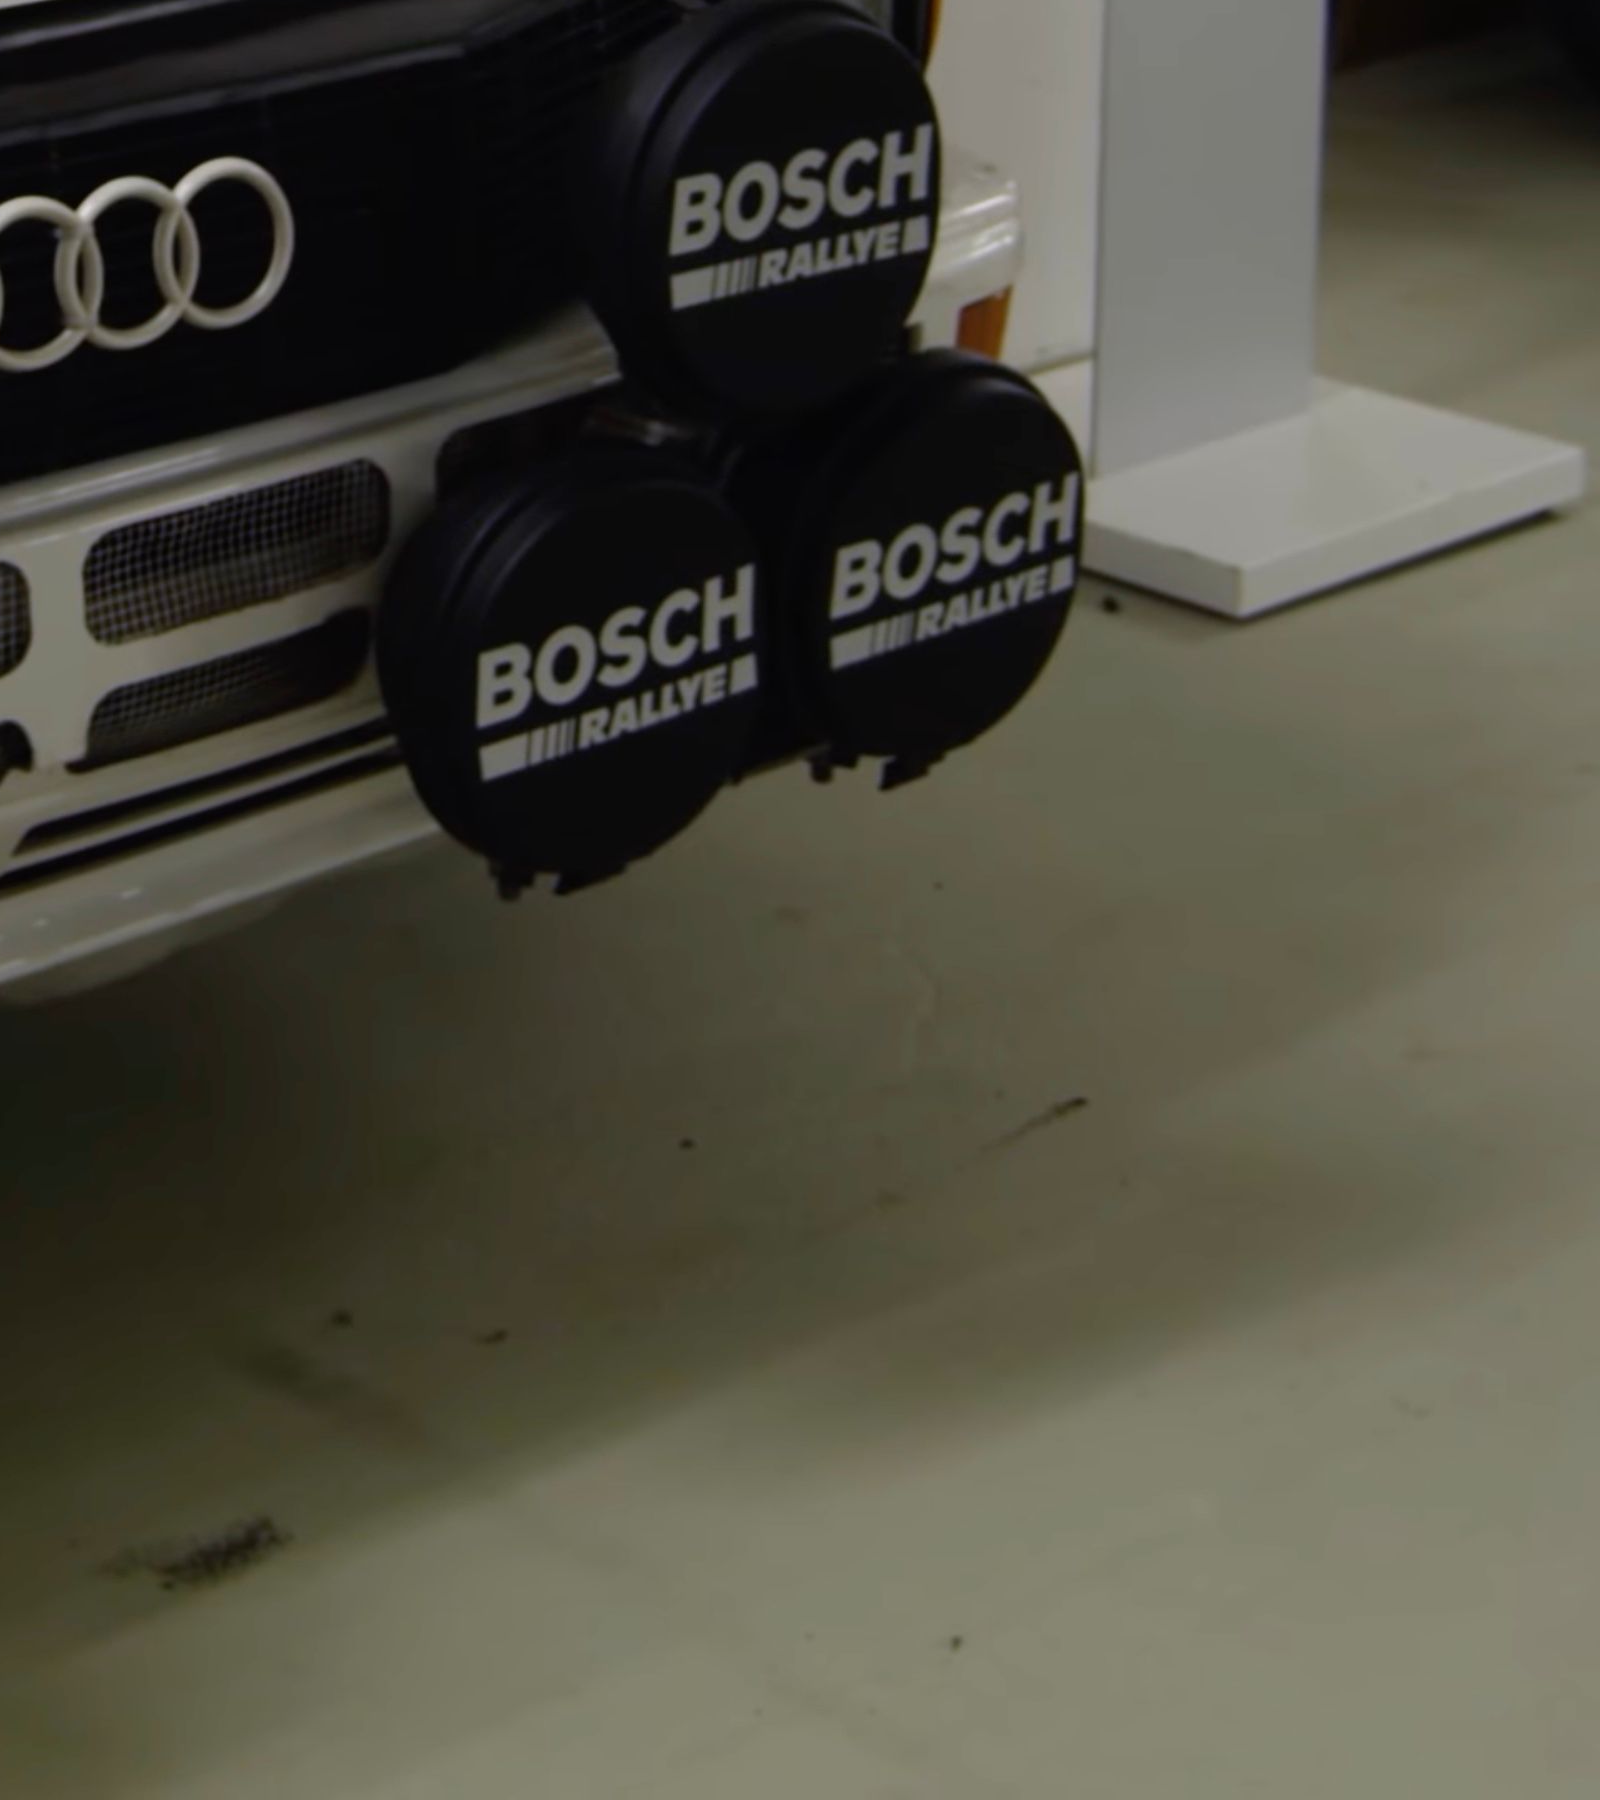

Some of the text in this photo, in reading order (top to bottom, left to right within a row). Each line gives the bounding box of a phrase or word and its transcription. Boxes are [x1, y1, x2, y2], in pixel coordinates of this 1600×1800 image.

[667, 122, 934, 257] BOSCH
[756, 218, 902, 289] RALLYE
[829, 471, 1081, 623] BOSCH
[474, 562, 756, 731] BOSCH
[915, 565, 1048, 643] RALLYE
[577, 662, 728, 749] RALLYE
